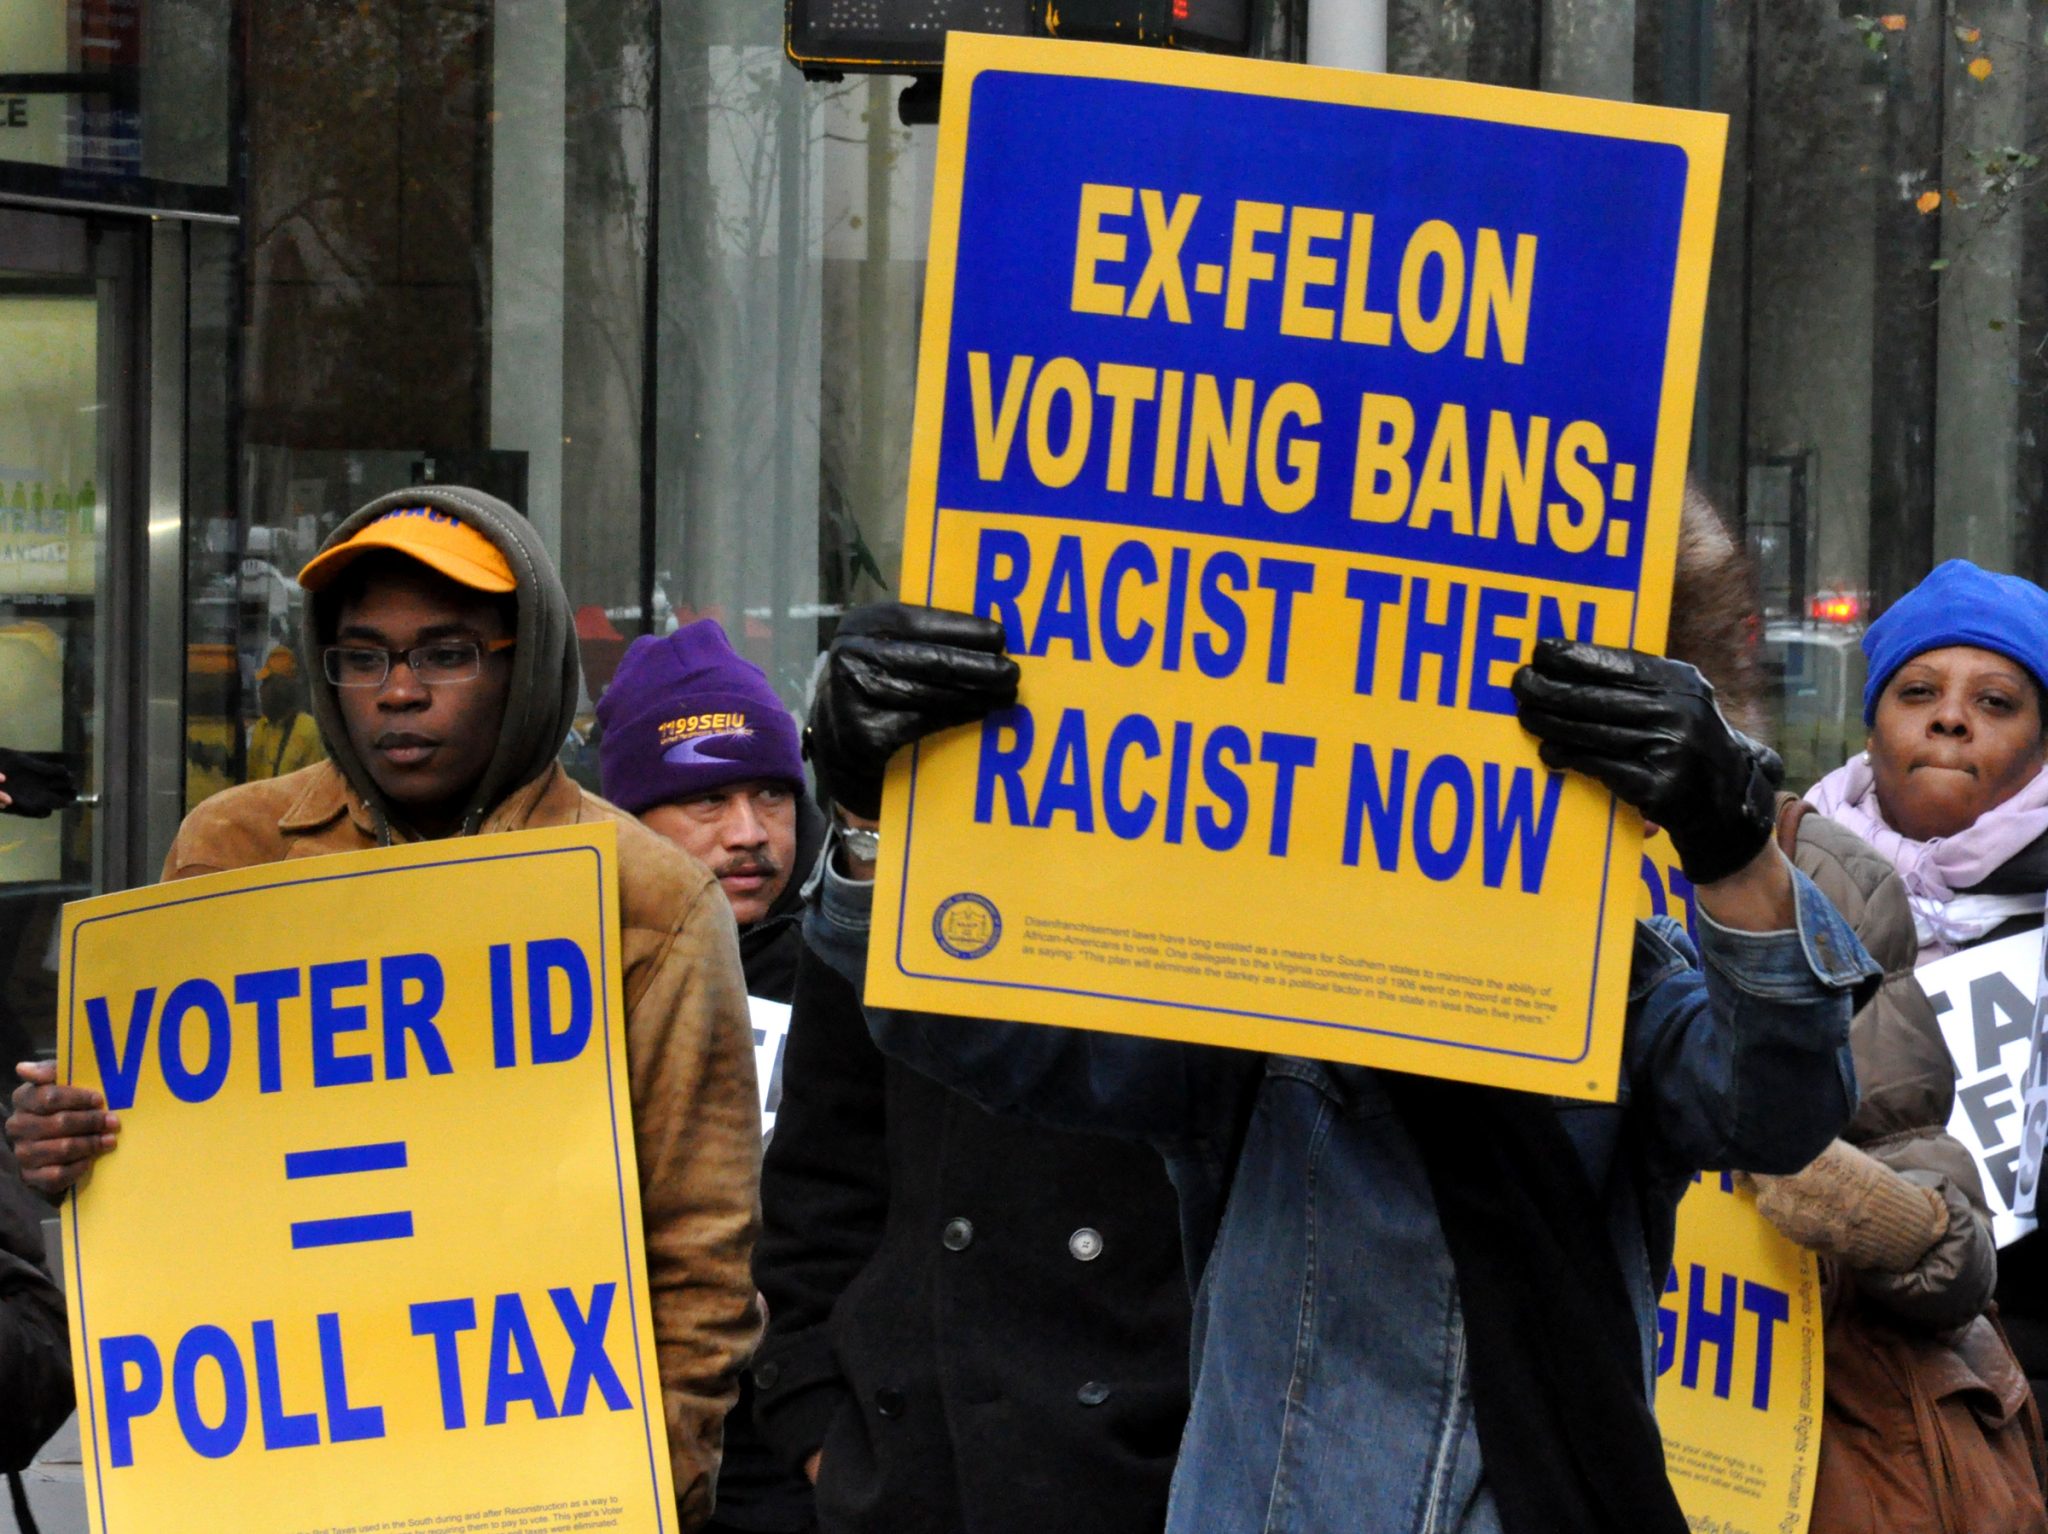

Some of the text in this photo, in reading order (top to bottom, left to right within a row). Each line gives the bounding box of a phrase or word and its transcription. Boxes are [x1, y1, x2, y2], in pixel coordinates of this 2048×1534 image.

[1072, 184, 1537, 364] EX-FELON
[969, 351, 1636, 556] VOTING BANS:
[974, 529, 1314, 683] RACIST
[658, 713, 745, 738] 1199SEIU
[974, 705, 1563, 894] RACIST NOW
[1022, 945, 1034, 953] as
[1107, 955, 1130, 966] plan
[1134, 959, 1150, 968] will
[1154, 961, 1200, 974] eliminate
[1204, 967, 1220, 977] the
[1224, 970, 1259, 984] darkey
[1263, 976, 1276, 984] as
[1279, 977, 1286, 985] a
[1288, 979, 1328, 991] political
[1332, 983, 1361, 995] factor
[1364, 989, 1374, 997] in
[1378, 990, 1394, 1001] this
[1399, 994, 1424, 1005] state
[1428, 999, 1437, 1007] in
[1440, 1000, 1461, 1011] less
[1464, 1004, 1487, 1015] than
[1490, 1007, 1510, 1018] five
[1024, 930, 1119, 950] African-Americans
[1122, 943, 1133, 952] to
[1164, 947, 1188, 958] One
[1191, 952, 1236, 965] delegate
[1240, 958, 1250, 966] to
[1253, 958, 1269, 969] the
[1274, 961, 1312, 975] Virginia
[1316, 968, 1372, 983] convention
[1376, 976, 1386, 985] of
[1420, 984, 1444, 994] went
[1447, 988, 1460, 997] on
[1464, 991, 1497, 1002] record
[1500, 996, 1511, 1004] at
[1514, 997, 1531, 1007] the
[1534, 1000, 1557, 1011] time
[1025, 916, 1129, 937] Disenfranchisement
[1132, 929, 1155, 941] laws
[1158, 933, 1185, 945] have
[1188, 937, 1211, 950] long
[1214, 941, 1252, 953] existed
[1254, 946, 1267, 955] as
[1280, 950, 1316, 961] means
[1320, 953, 1333, 963] for
[1337, 955, 1385, 970] Southern
[1389, 964, 1419, 977] states
[1423, 969, 1433, 979] to
[1436, 972, 1484, 986] minimize
[1486, 978, 1504, 989] the
[1506, 982, 1536, 996] ability
[1540, 987, 1551, 996] of
[86, 938, 593, 1111] VOTER ID
[285, 1142, 413, 1249] =
[100, 1283, 632, 1467] POLL TAX
[359, 1523, 379, 1531] used
[408, 1516, 432, 1526] South
[434, 1514, 461, 1524] during
[464, 1511, 480, 1519] and
[482, 1509, 500, 1517] after
[504, 1502, 566, 1515] Reconstruction
[590, 1498, 607, 1506] way
[501, 1520, 516, 1528] pay
[554, 1512, 570, 1520] This
[574, 1509, 598, 1520] year's
[600, 1505, 622, 1515] Voter
[551, 1524, 570, 1532] were
